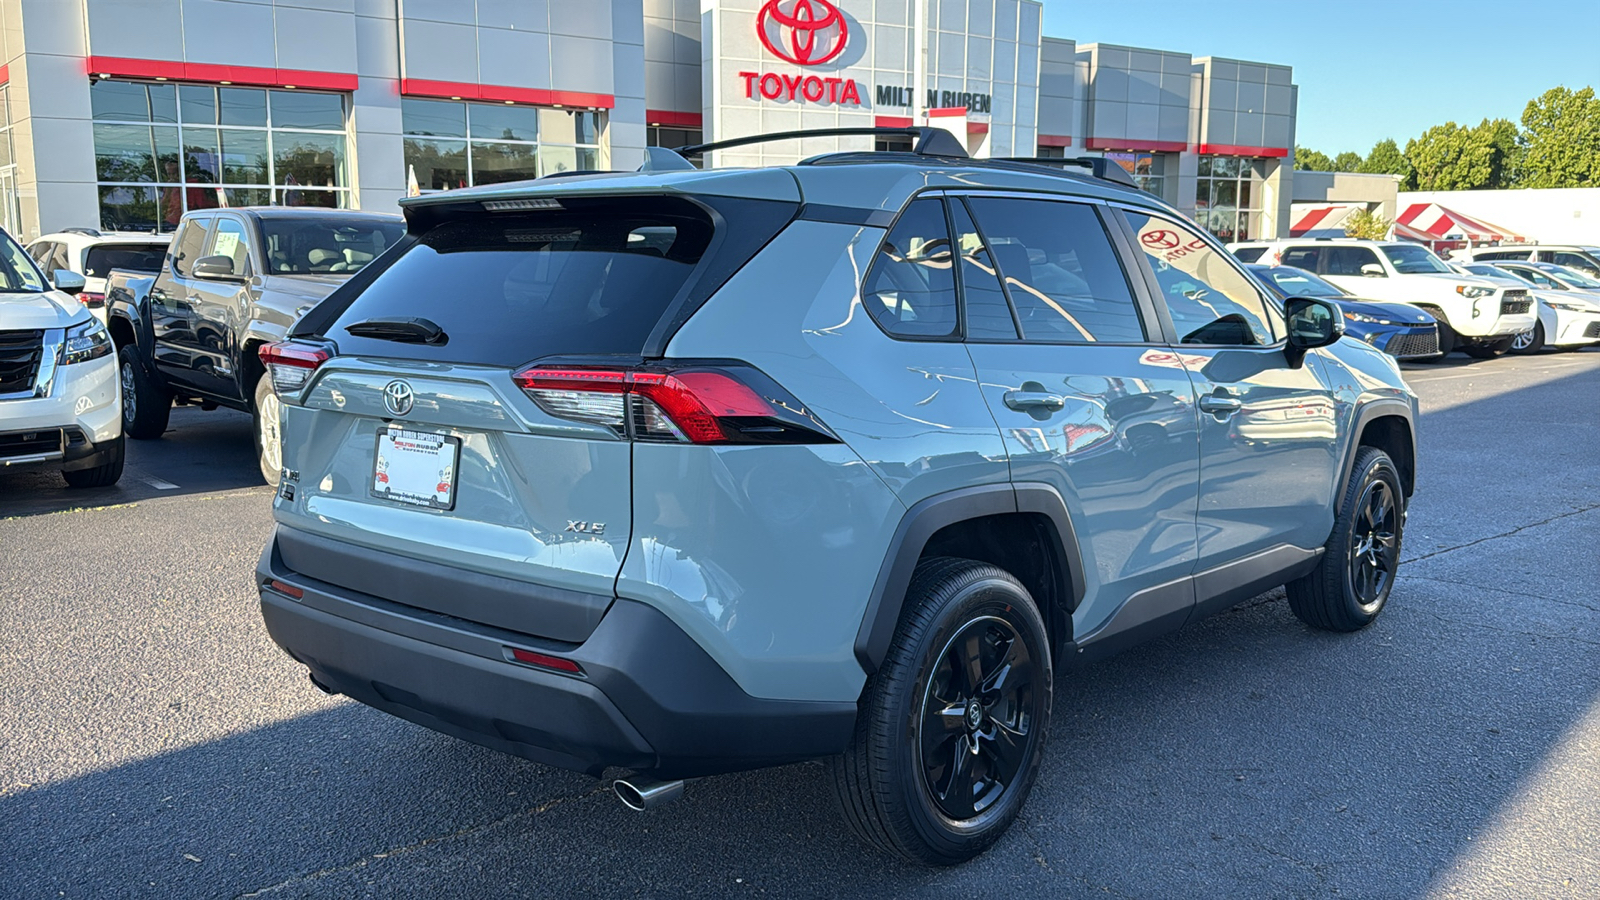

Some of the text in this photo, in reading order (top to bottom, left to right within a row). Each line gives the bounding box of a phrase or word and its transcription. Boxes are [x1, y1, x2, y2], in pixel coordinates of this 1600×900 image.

[739, 71, 861, 105] TOYOTA
[876, 85, 991, 113] MILTN RUBEN
[394, 440, 439, 451] MILTON RUBEN
[402, 447, 438, 455] SUPERSTORE
[564, 519, 606, 535] XLE
